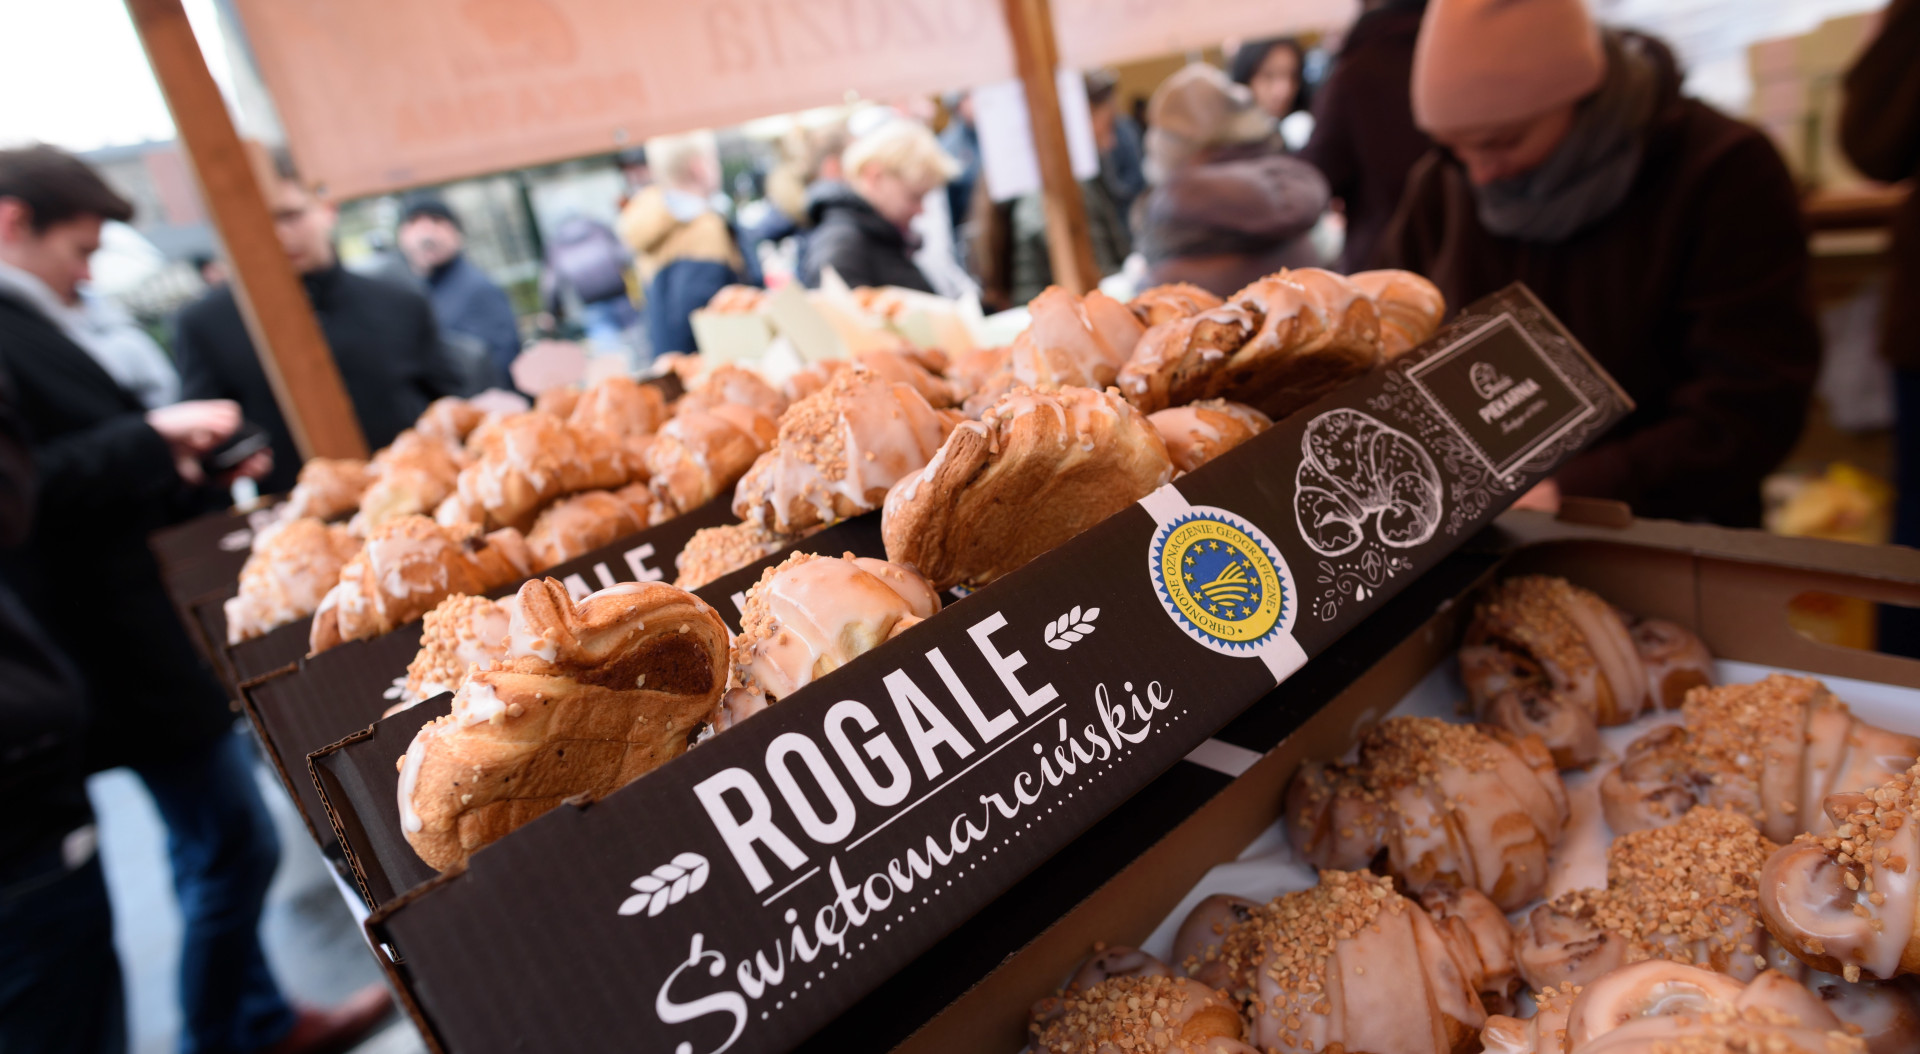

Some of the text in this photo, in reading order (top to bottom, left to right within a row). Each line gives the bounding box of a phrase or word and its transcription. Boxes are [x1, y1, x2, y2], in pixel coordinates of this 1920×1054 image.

[1479, 378, 1541, 424] PIEKARNIA
[1166, 524, 1276, 636] CHRONIONE OZNACZENIE GEOGRAFICZNE
[693, 611, 1059, 893] ROGALE
[655, 680, 1174, 1054] Świętomarcińskie
